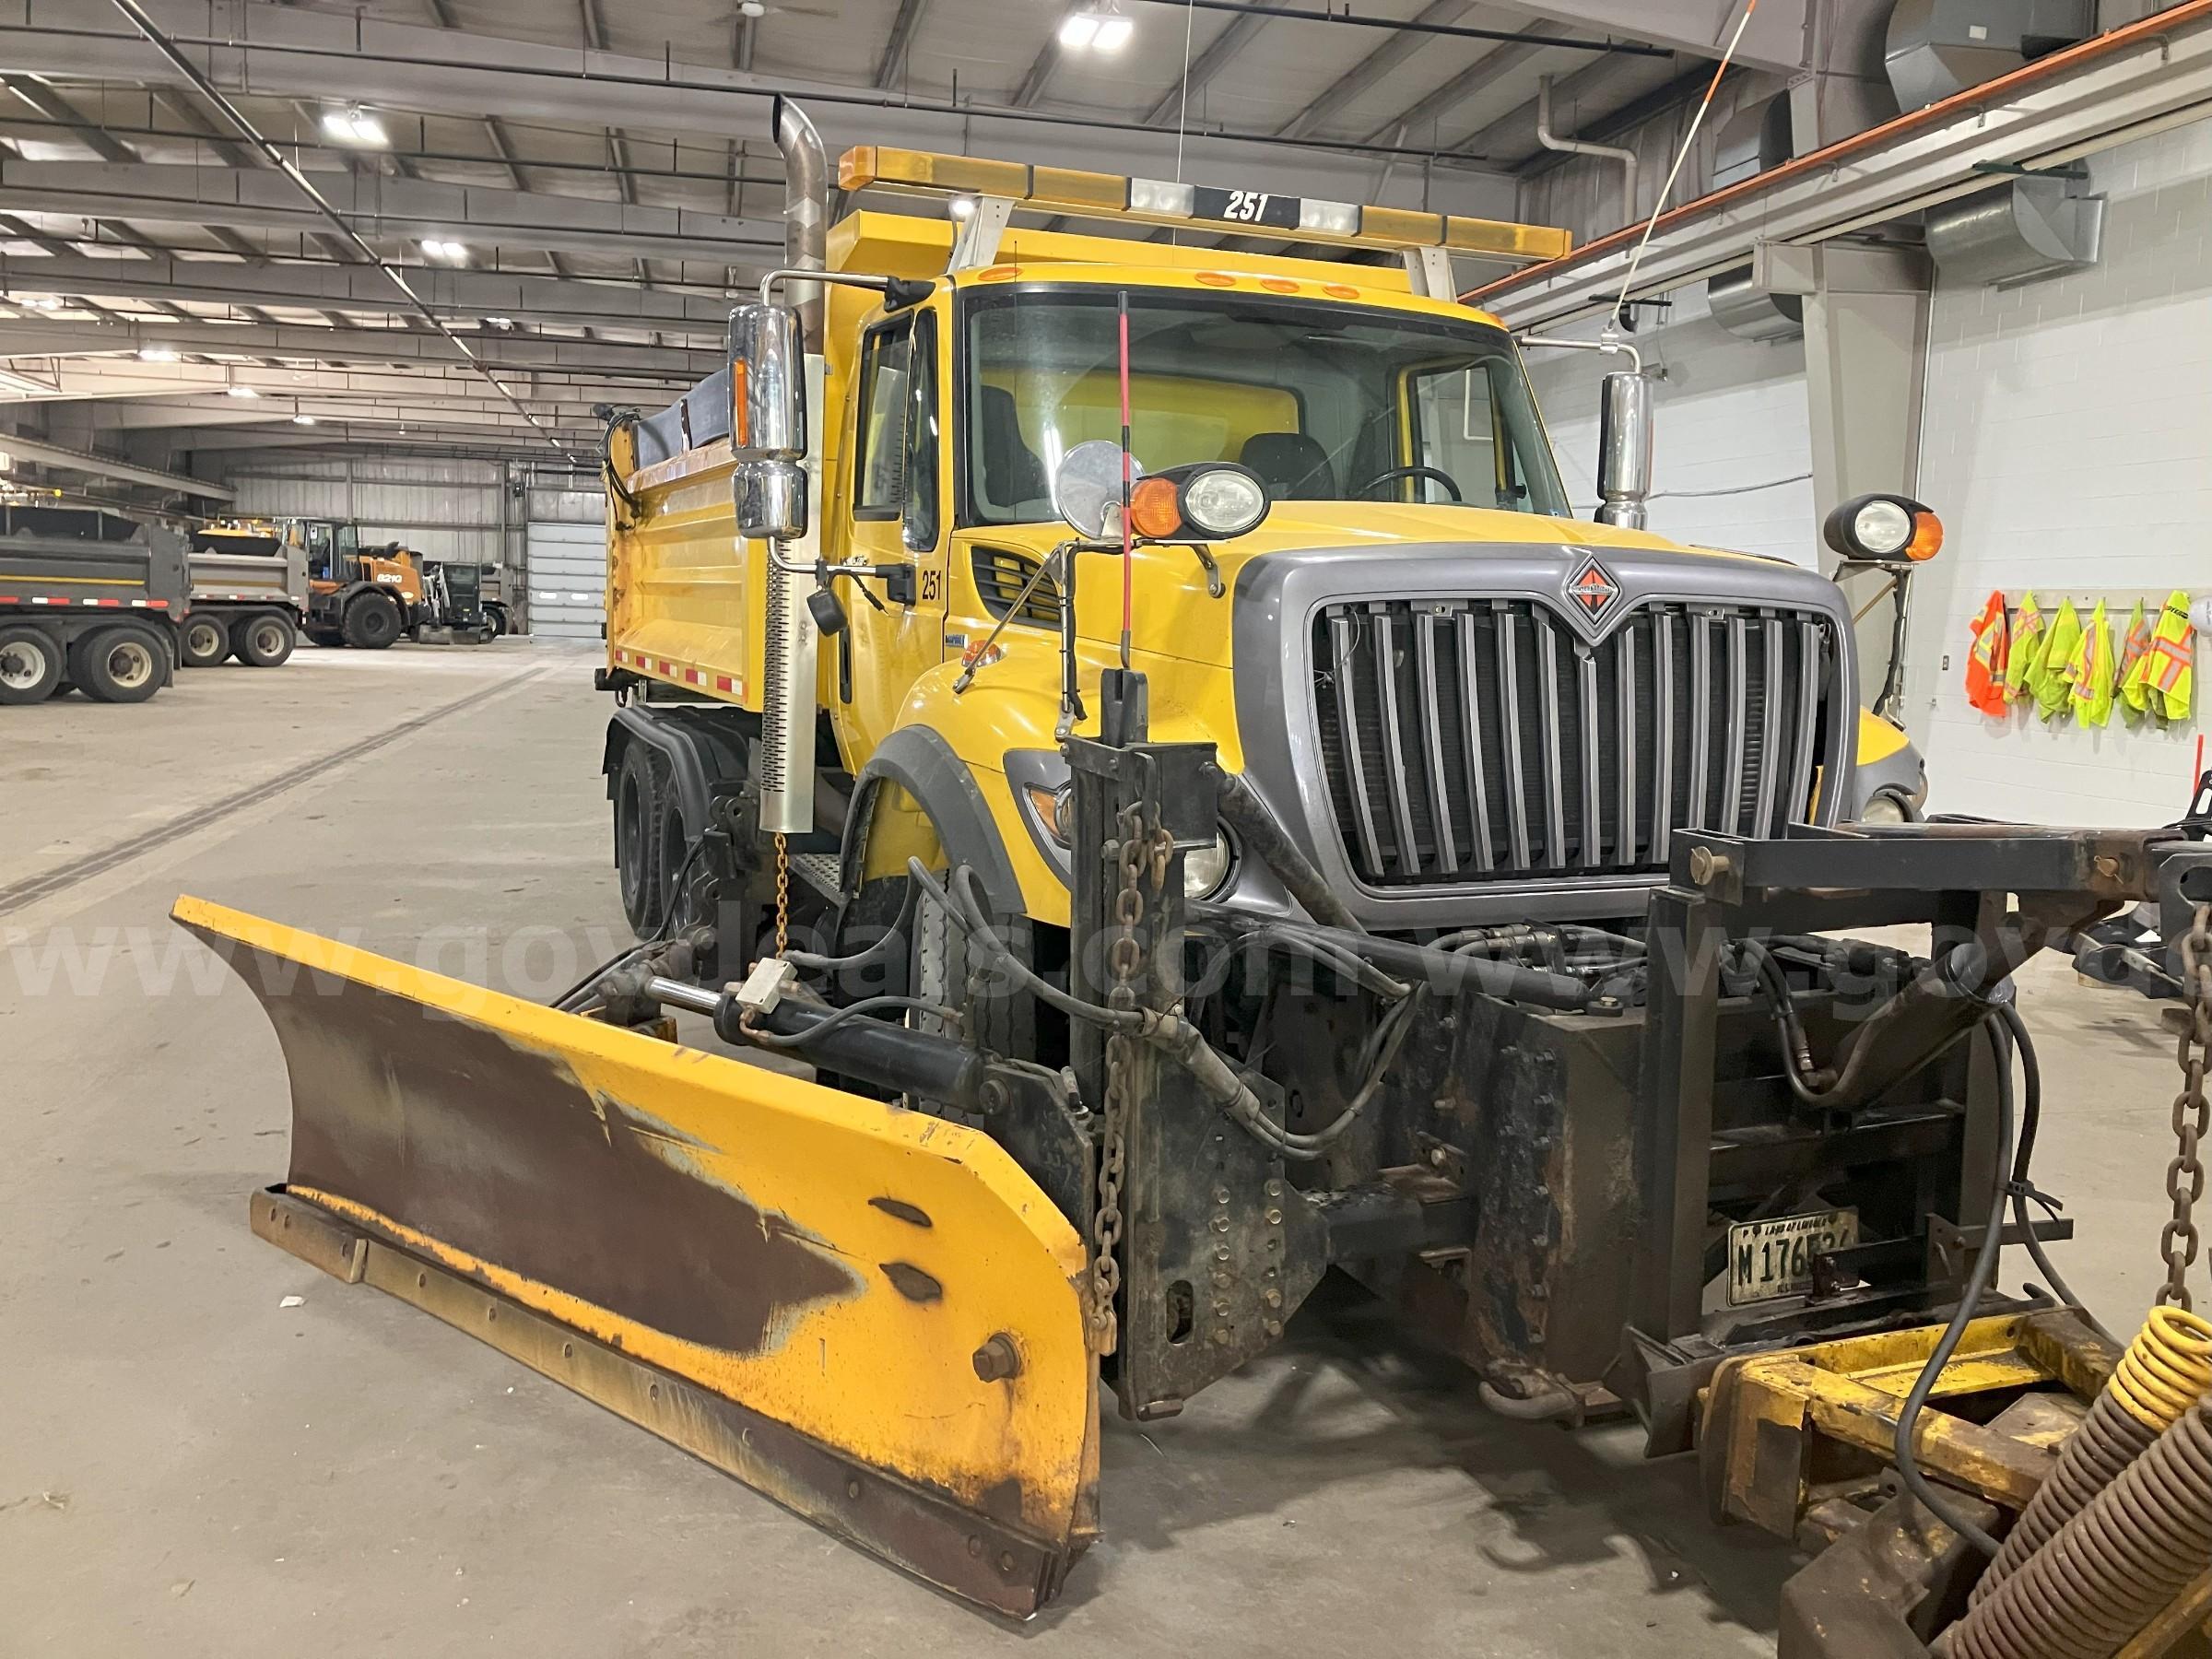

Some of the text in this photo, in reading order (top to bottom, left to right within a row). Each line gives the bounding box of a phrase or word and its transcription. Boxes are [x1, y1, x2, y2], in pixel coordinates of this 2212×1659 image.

[1223, 190, 1269, 222] 251
[377, 573, 403, 583] 821G
[923, 570, 942, 600] 251
[1737, 1242, 1752, 1287] M
